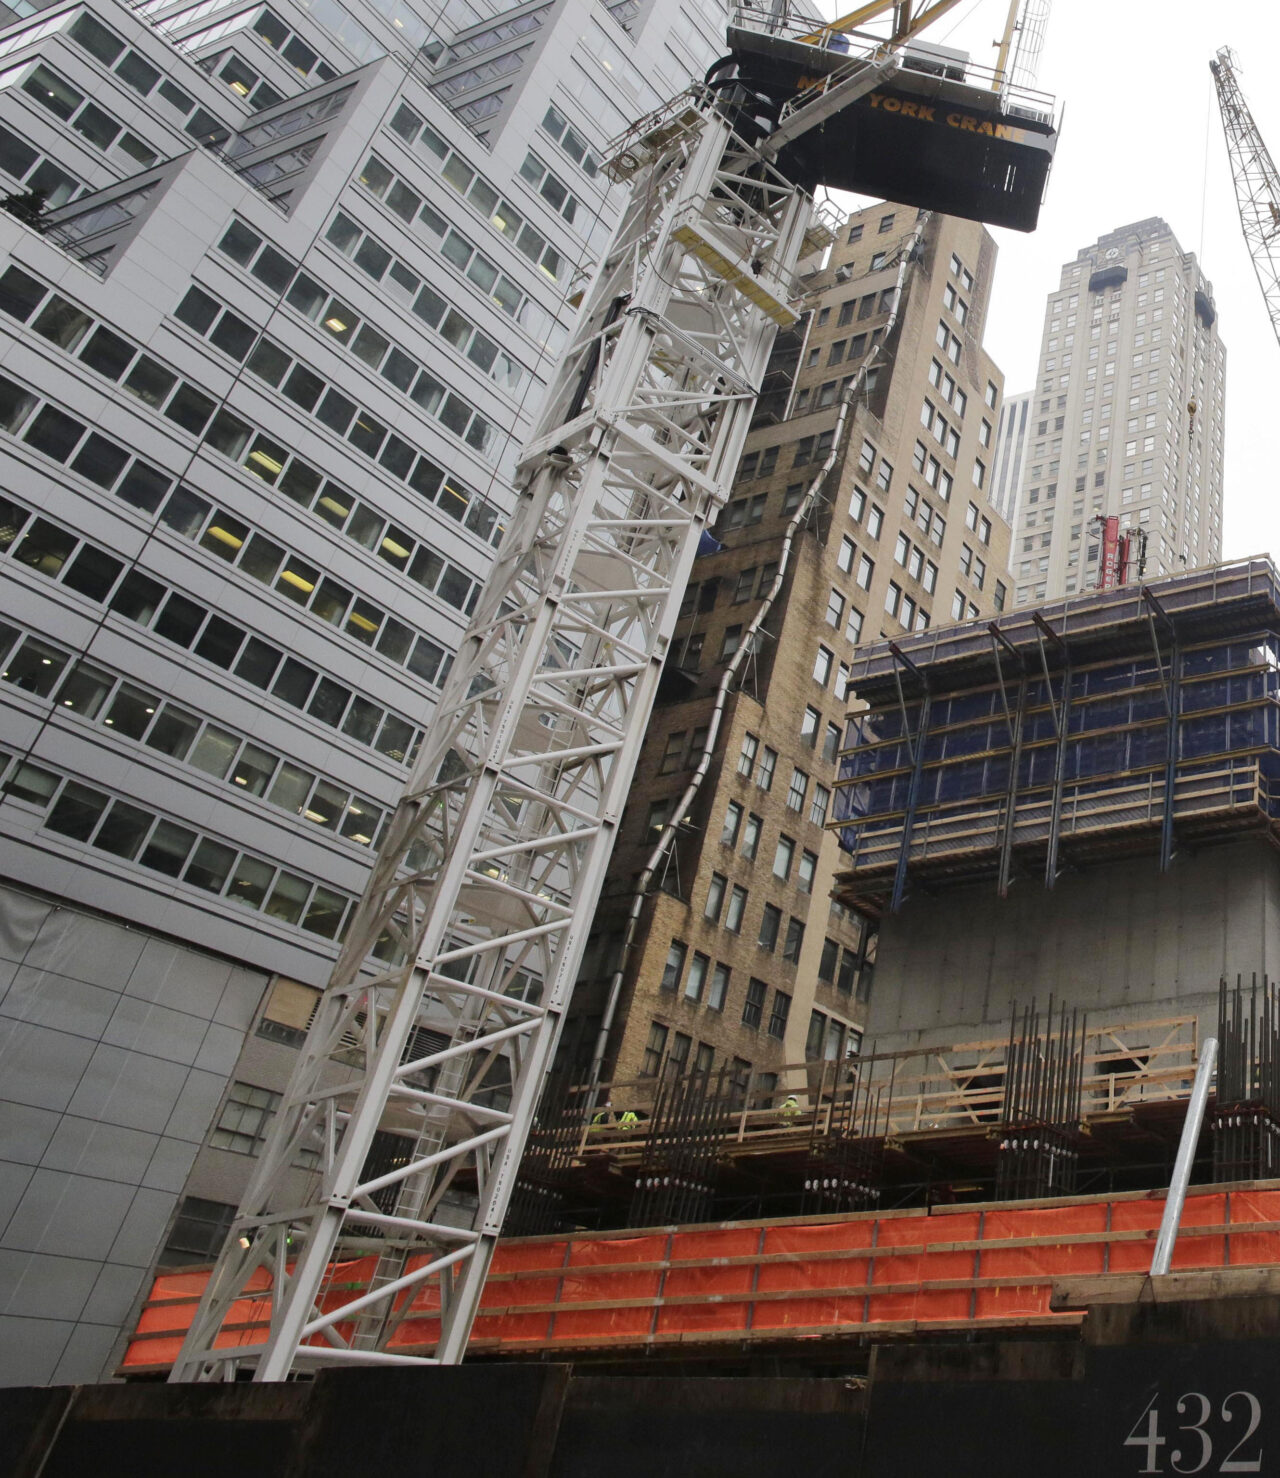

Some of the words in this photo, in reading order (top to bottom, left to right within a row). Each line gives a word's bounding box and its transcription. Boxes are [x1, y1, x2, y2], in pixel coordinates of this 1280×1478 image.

[868, 92, 937, 122] YORK
[945, 112, 1028, 144] CRANE
[1123, 1391, 1263, 1474] 432
